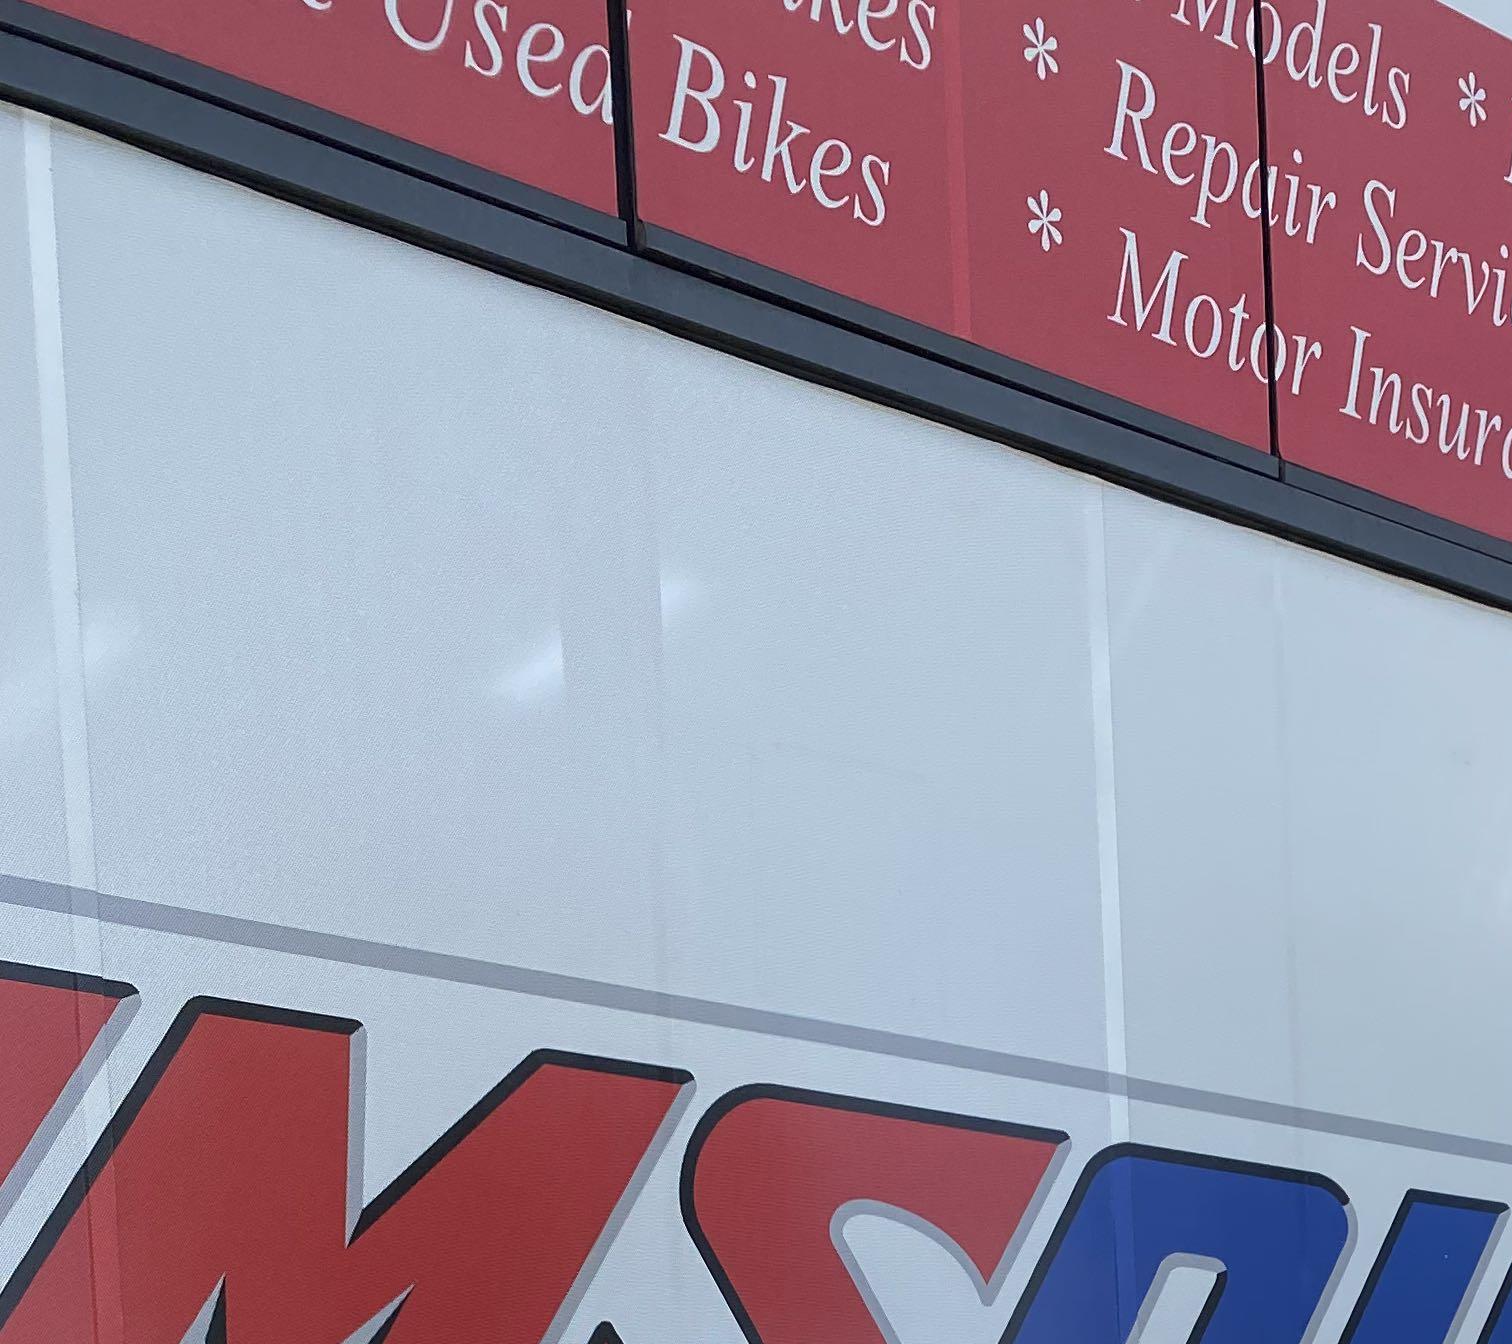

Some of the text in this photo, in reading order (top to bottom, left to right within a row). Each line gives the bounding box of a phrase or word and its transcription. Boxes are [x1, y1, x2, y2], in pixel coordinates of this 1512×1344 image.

[658, 33, 891, 228] Bikes
[1103, 58, 1337, 247] Repair
[1106, 227, 1323, 395] Motor
